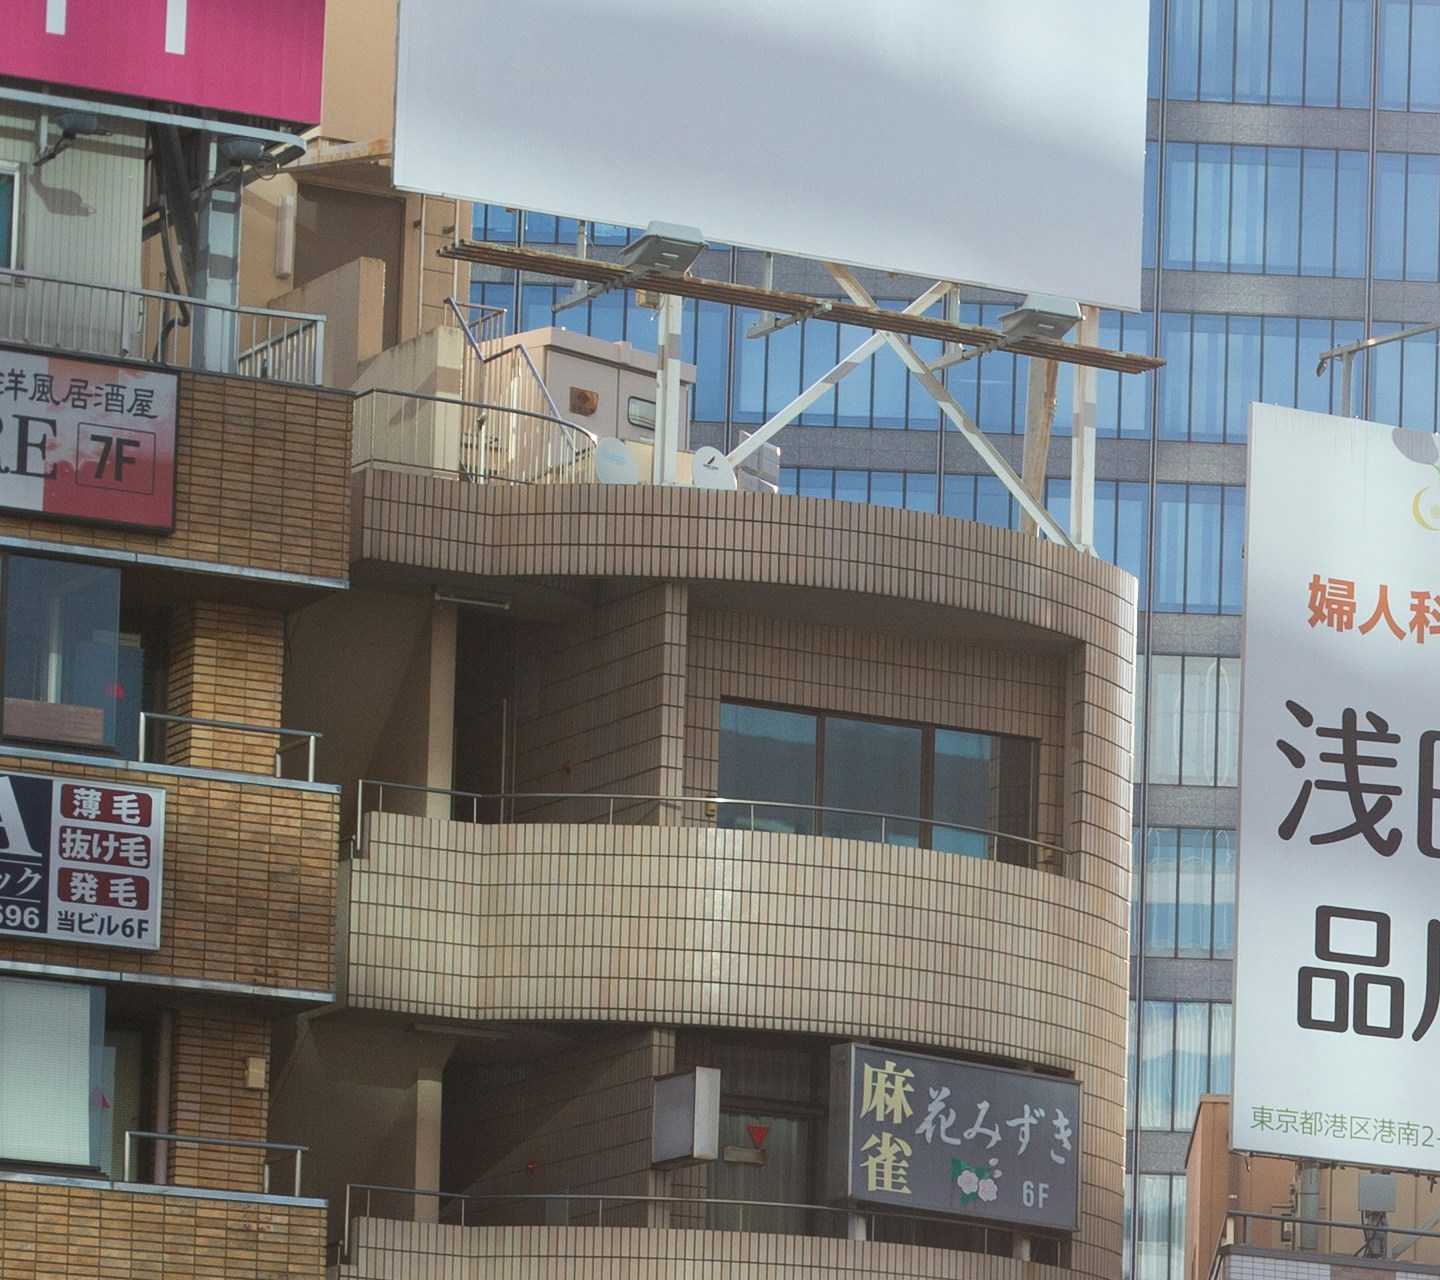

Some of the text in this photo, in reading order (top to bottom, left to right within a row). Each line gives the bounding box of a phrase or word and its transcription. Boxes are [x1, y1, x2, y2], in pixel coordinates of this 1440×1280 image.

[89, 434, 141, 482] 7F
[72, 787, 141, 826] 薄毛
[61, 827, 149, 868] 抜け毛
[69, 871, 138, 909] 発毛
[56, 910, 150, 940] 当ビル6F
[859, 1060, 915, 1196] 麻雀
[915, 1086, 1074, 1166] 花みずき
[1022, 1180, 1051, 1209] 6F
